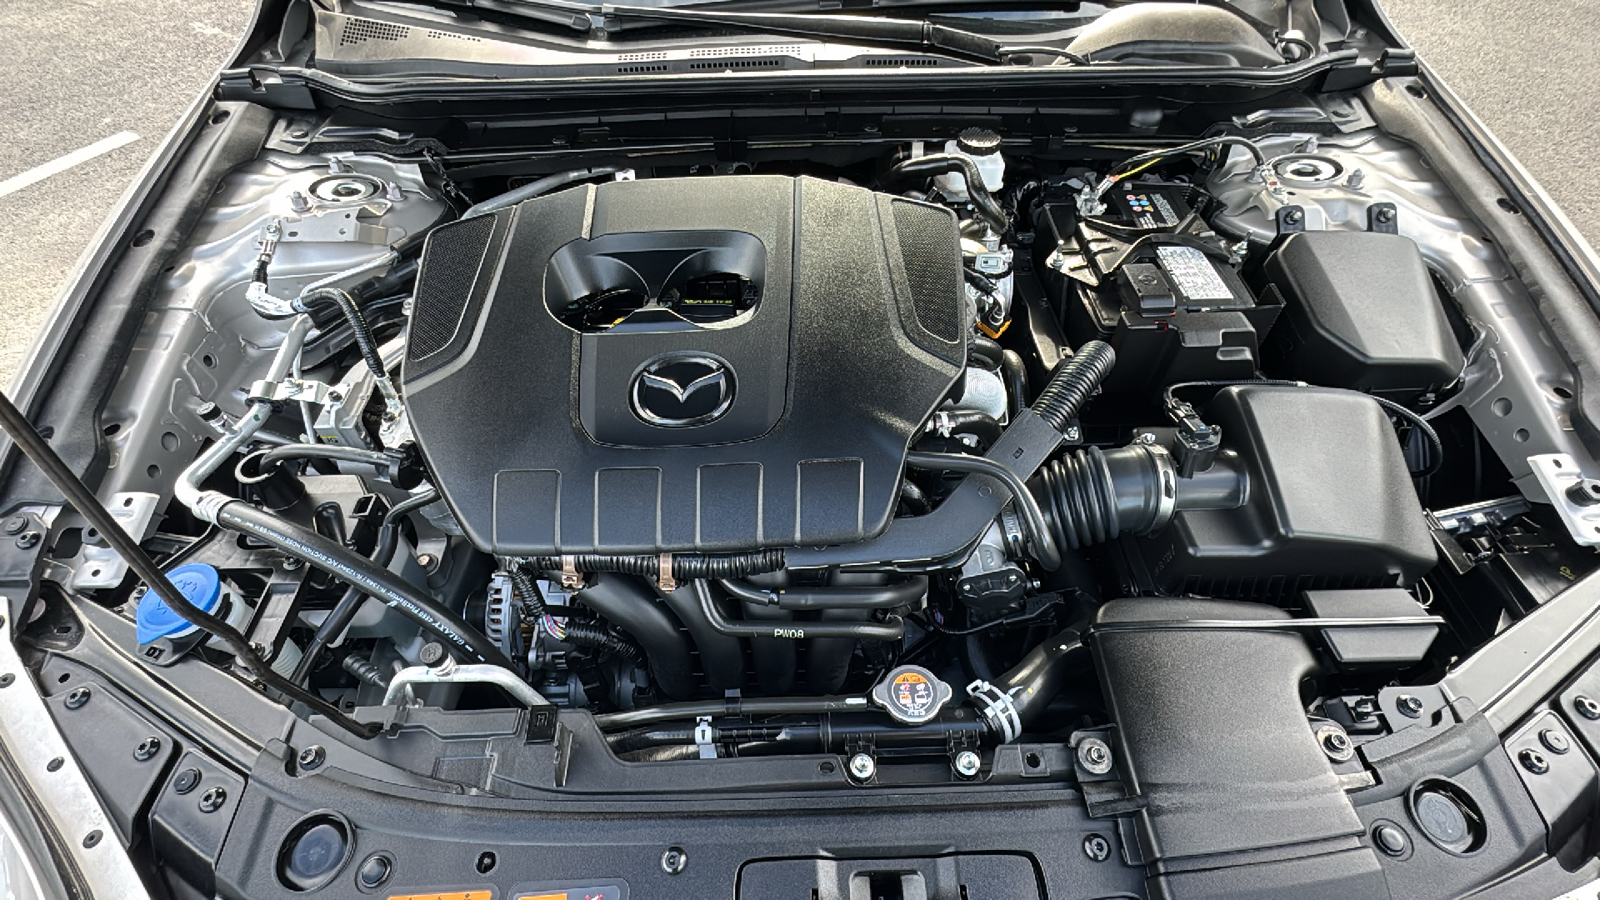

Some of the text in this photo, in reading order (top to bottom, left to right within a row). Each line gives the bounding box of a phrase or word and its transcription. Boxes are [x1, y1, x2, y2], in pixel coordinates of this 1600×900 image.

[284, 537, 301, 549] HOSE
[300, 544, 327, 561] SUCTION
[326, 557, 338, 567] A/C
[432, 622, 464, 646] GALAXY
[774, 628, 804, 639] PW08
